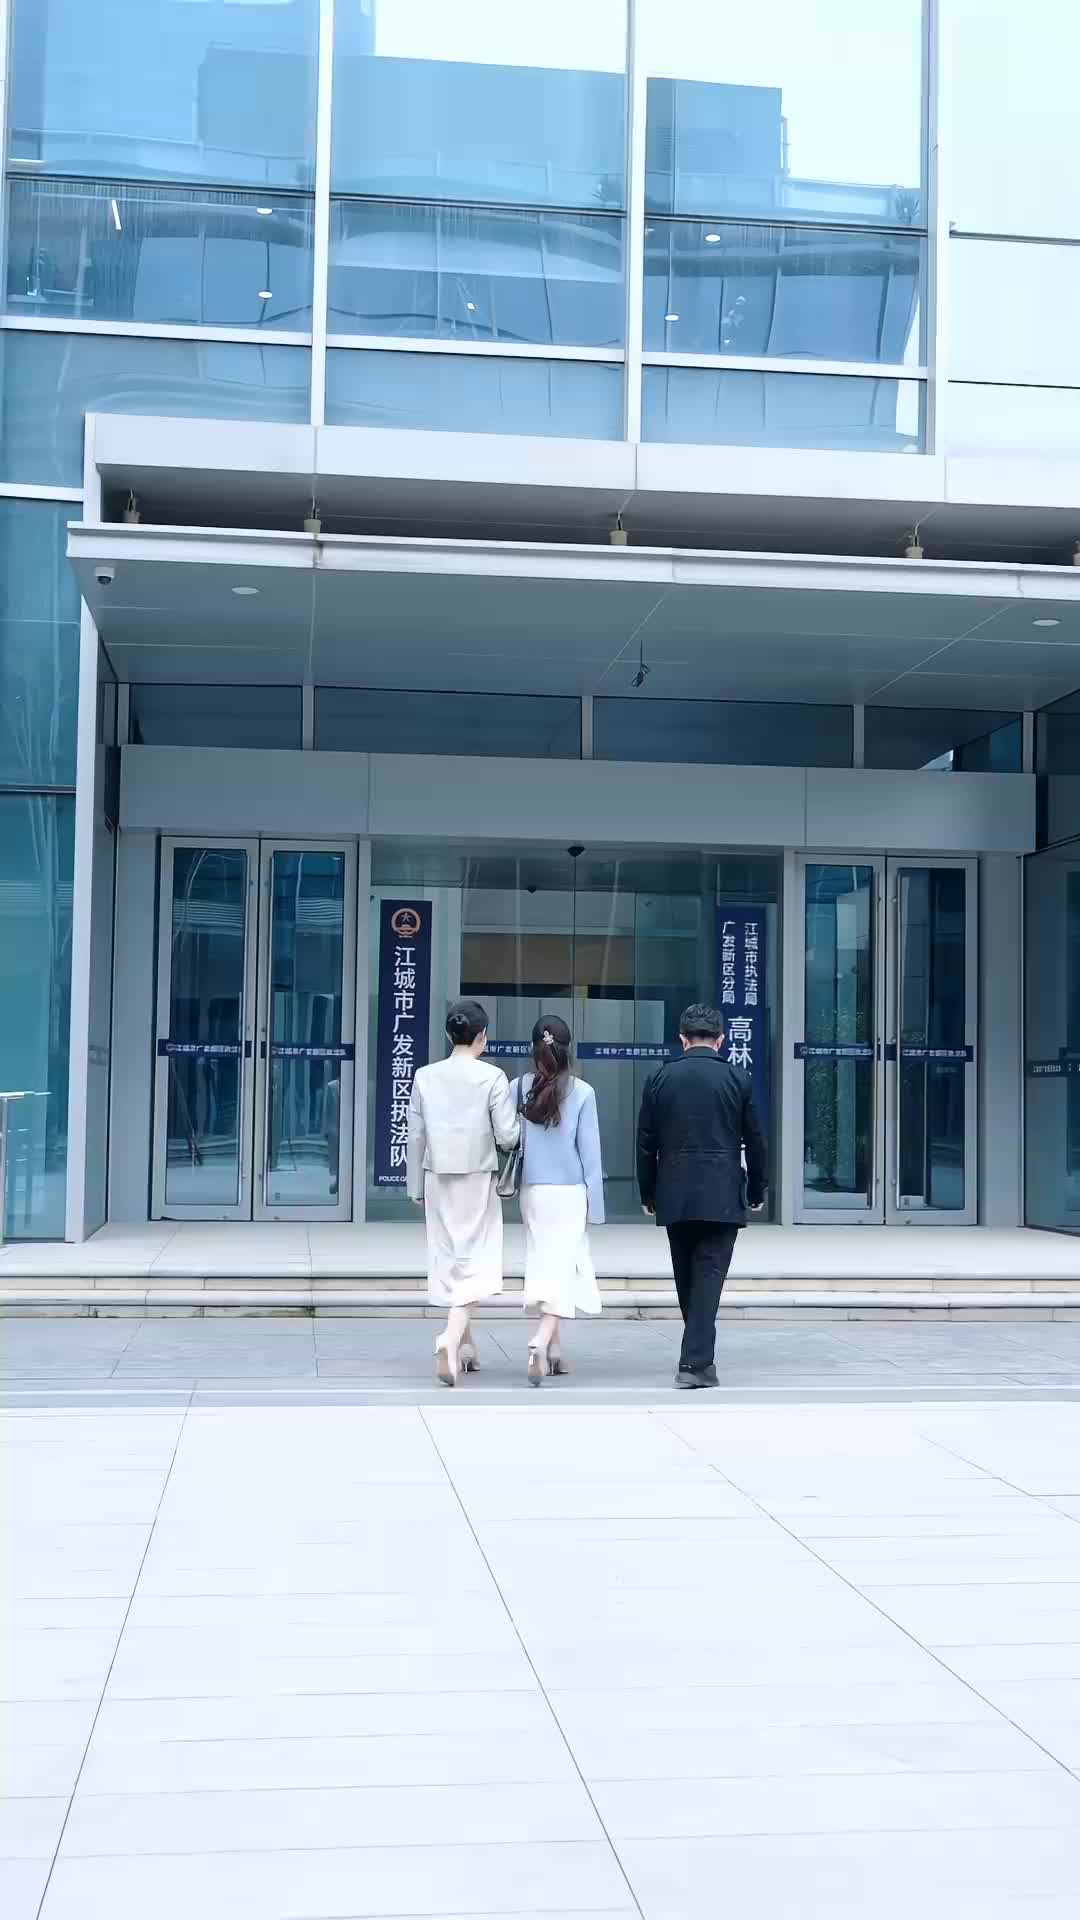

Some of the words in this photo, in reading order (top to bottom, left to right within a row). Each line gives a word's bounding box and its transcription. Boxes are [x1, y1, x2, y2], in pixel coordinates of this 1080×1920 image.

[390, 945, 416, 1168] 江城市广发新区执法队
[727, 1016, 753, 1076] 高林
